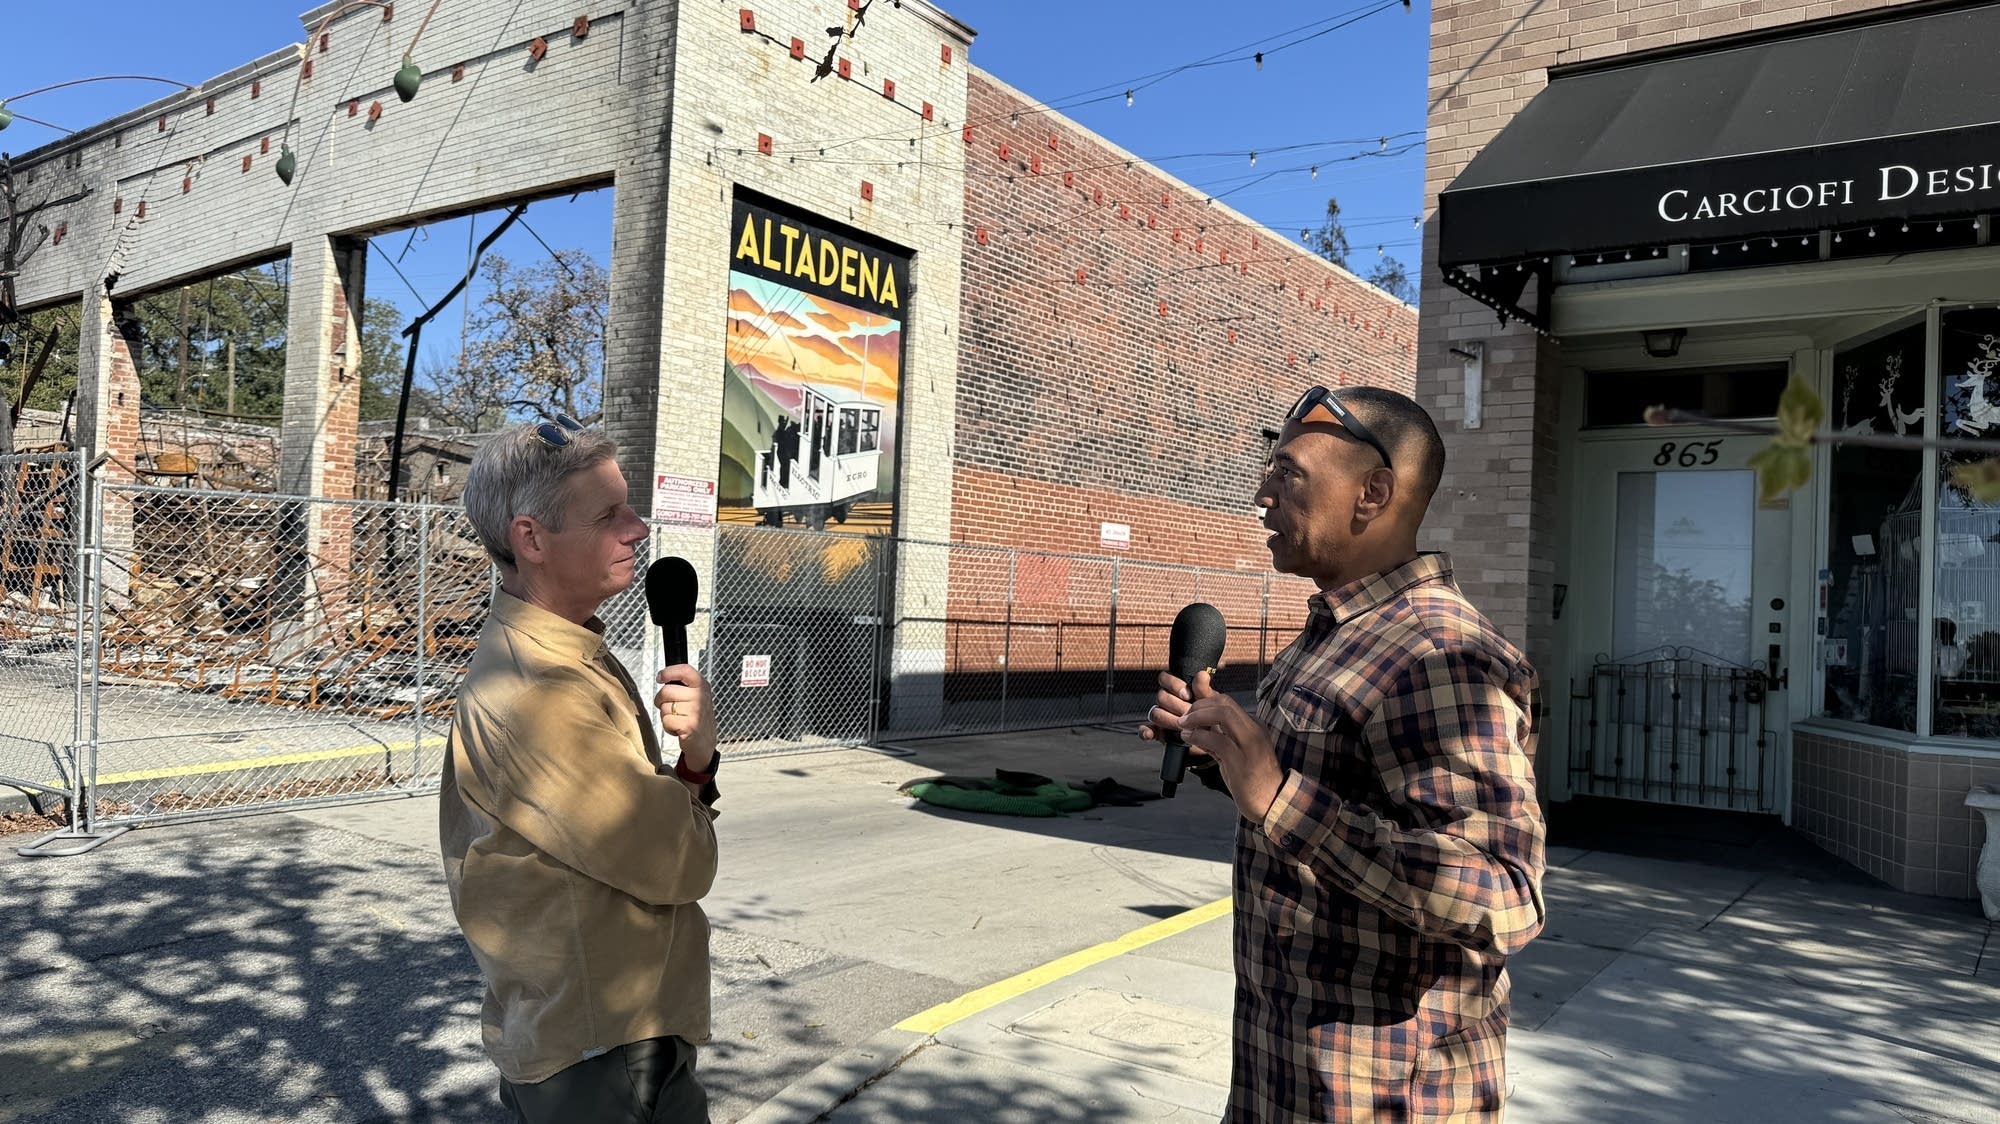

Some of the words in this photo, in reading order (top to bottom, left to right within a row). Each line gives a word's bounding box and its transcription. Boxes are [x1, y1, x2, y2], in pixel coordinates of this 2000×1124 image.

[1657, 179, 1854, 222] CARCIOFI
[1878, 163, 2000, 202] DESI
[735, 212, 899, 309] ALTADENA
[1653, 439, 1724, 467] 865
[660, 483, 692, 493] PARKING
[693, 487, 712, 495] ONLY
[846, 471, 868, 482] ECHO
